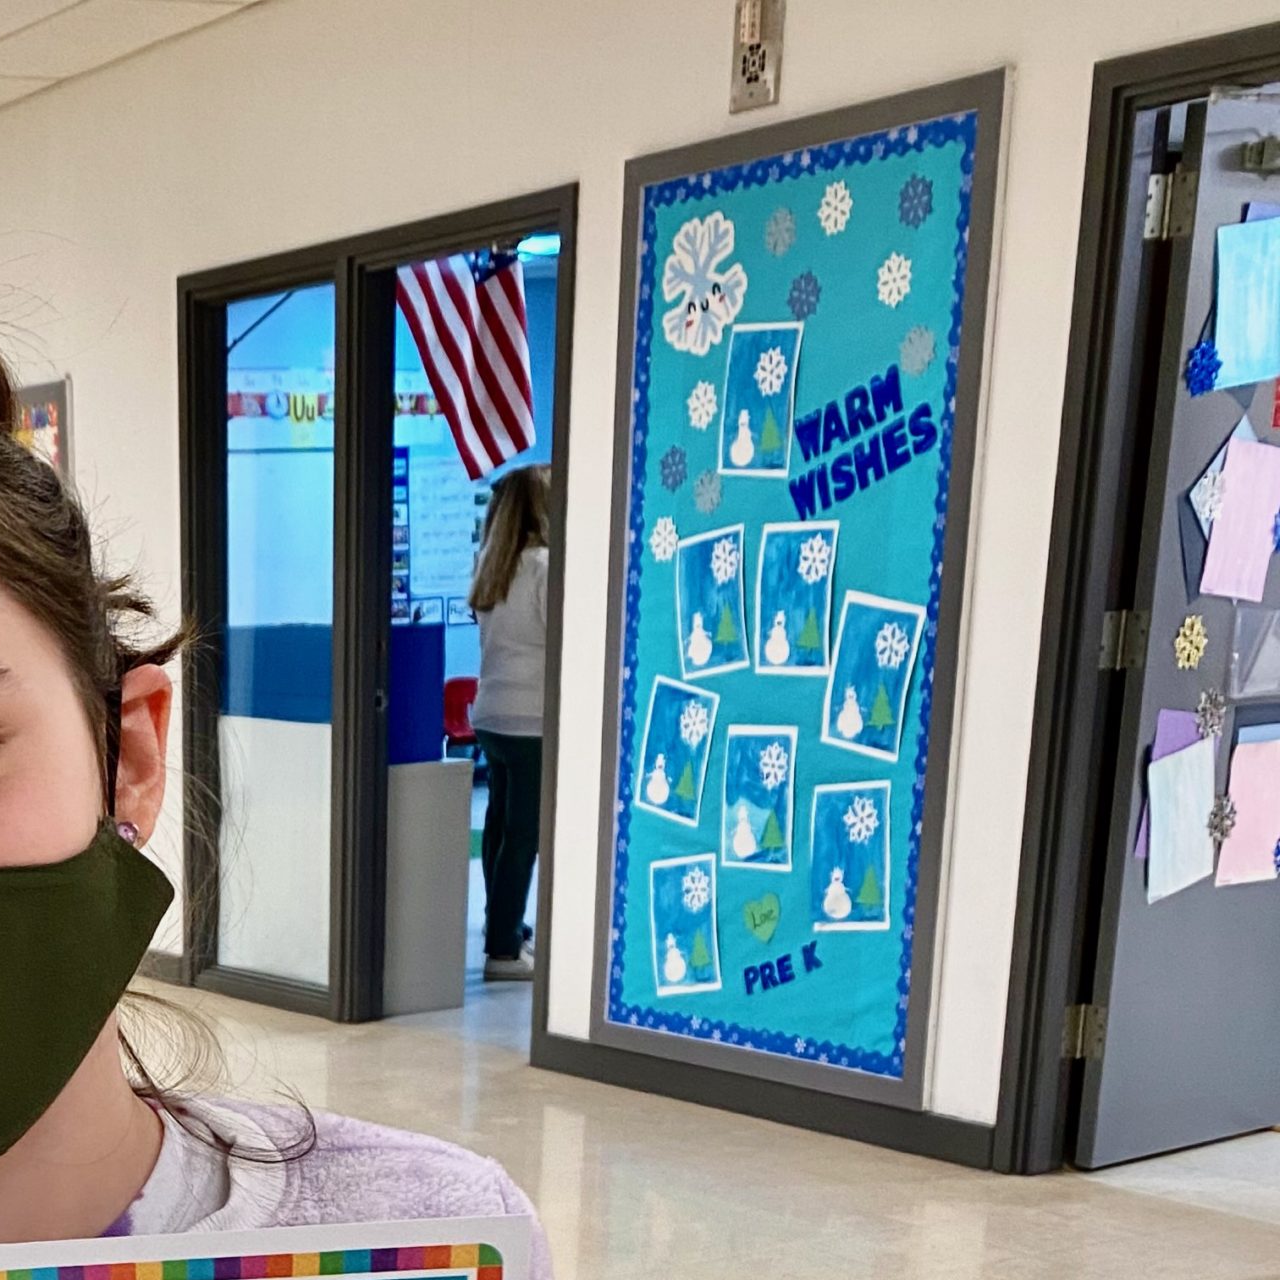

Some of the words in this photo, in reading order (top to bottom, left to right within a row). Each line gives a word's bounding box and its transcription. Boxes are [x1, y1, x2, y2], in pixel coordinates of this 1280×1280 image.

[788, 402, 939, 521] WISHES
[793, 364, 904, 463] WARM
[744, 953, 796, 996] PRE
[801, 940, 824, 973] K
